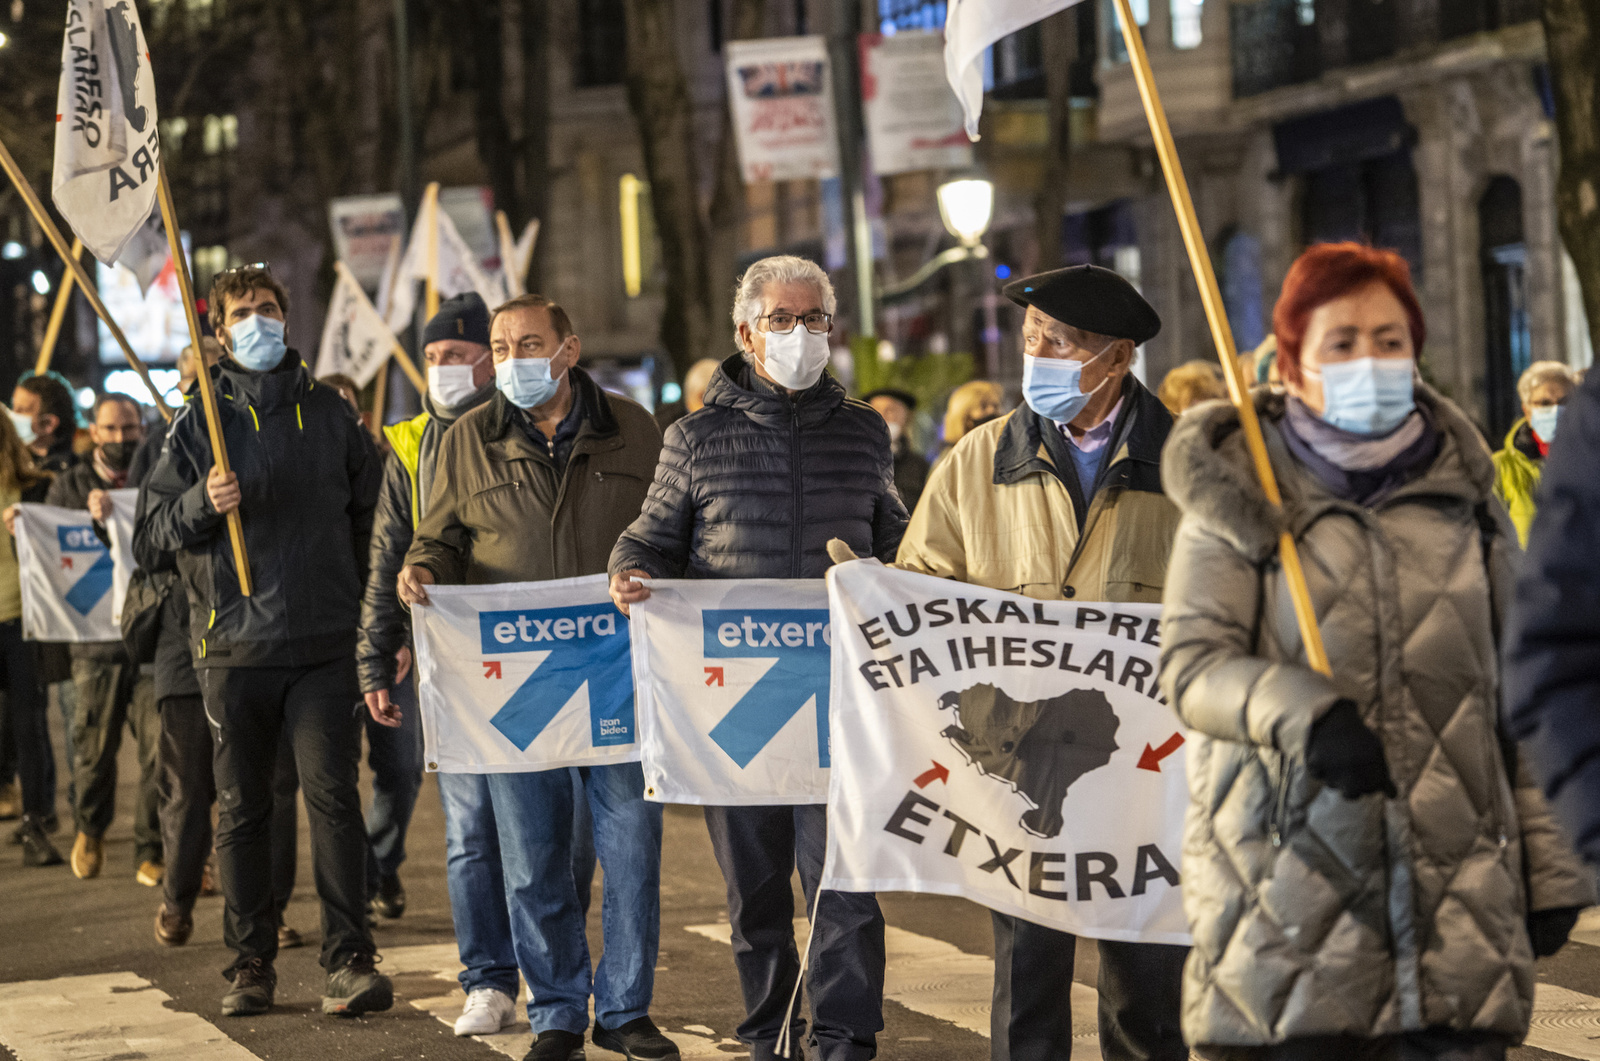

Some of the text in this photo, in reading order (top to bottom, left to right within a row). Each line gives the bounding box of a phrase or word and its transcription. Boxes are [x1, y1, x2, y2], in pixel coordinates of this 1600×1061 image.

[493, 612, 616, 644] etxera
[858, 597, 1060, 650] EUSKAL
[858, 636, 1168, 706] ETA IHESLARI
[599, 718, 621, 727] izan
[600, 725, 628, 736] bidea
[883, 789, 1181, 902] ETXERA
